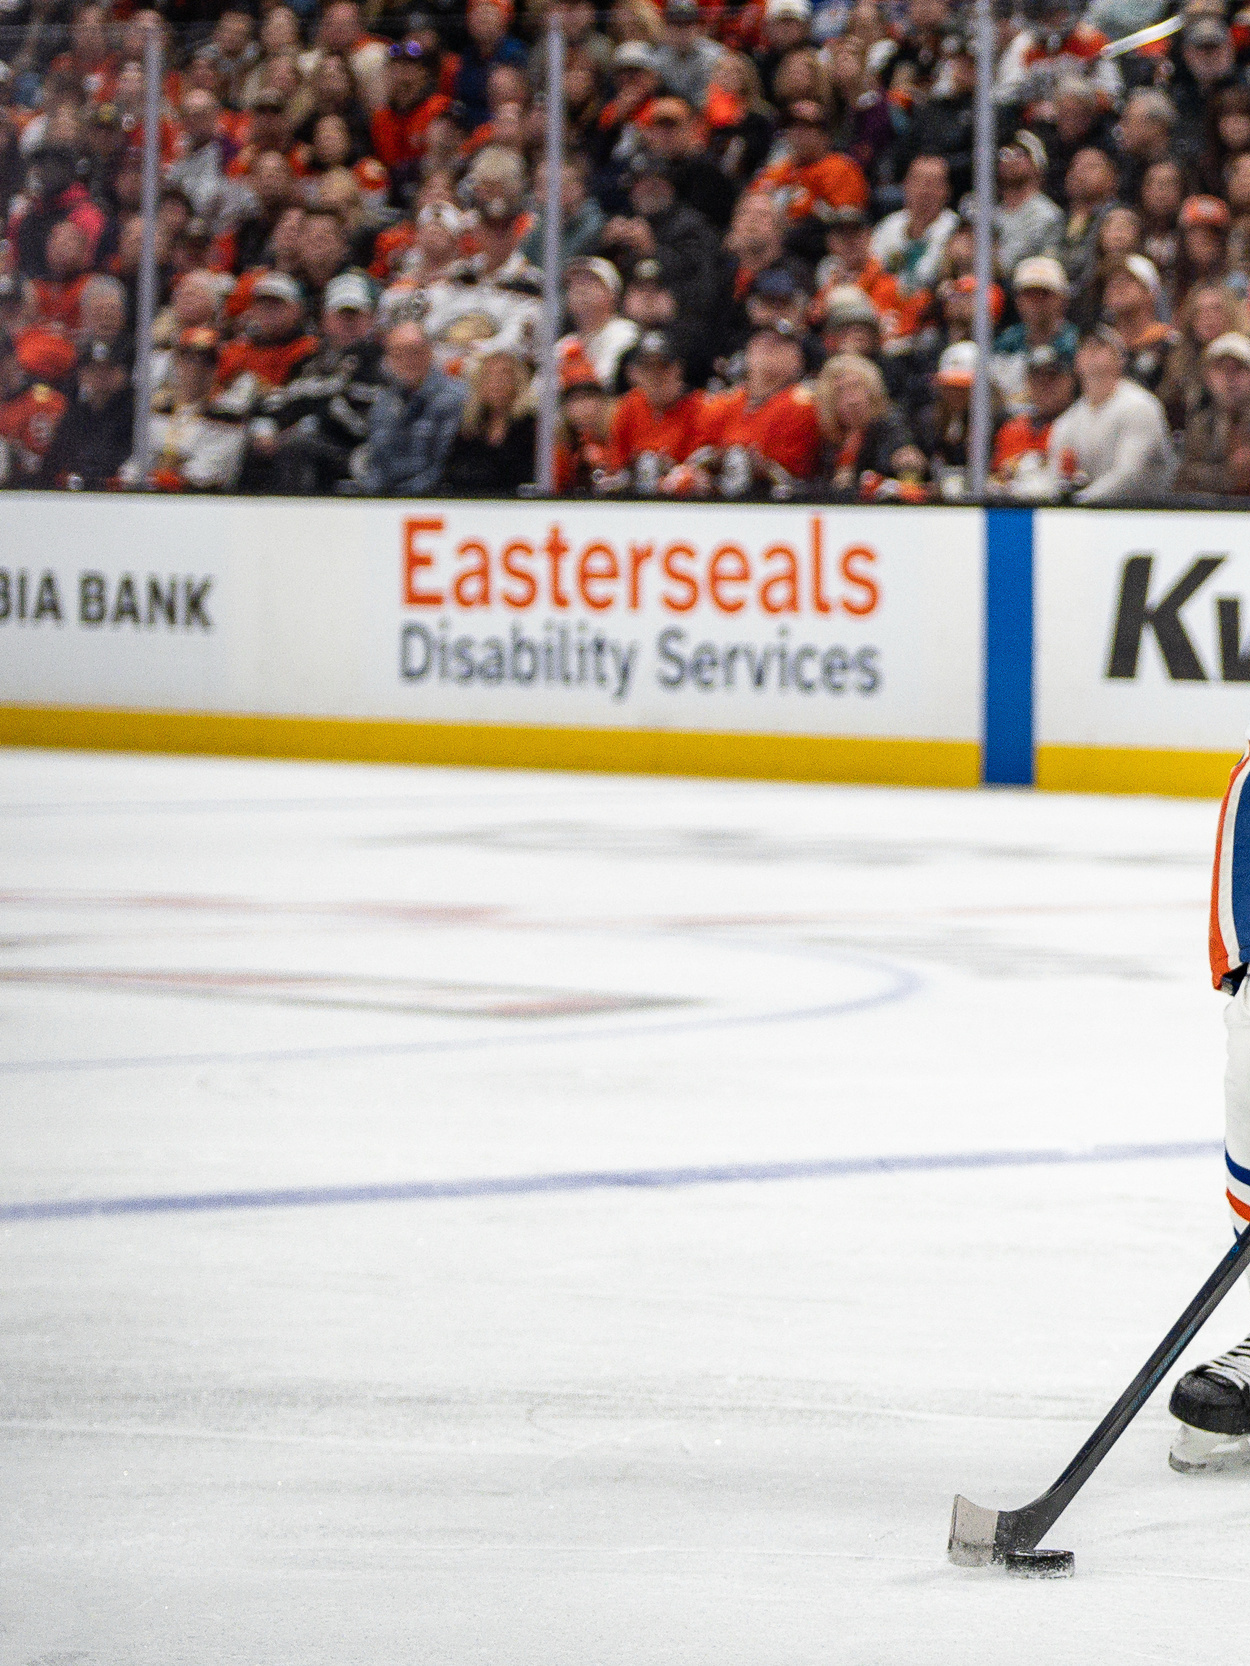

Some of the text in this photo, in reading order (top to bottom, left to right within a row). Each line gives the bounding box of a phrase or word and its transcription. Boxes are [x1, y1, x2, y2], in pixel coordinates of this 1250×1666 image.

[79, 572, 213, 627] BANK
[402, 512, 881, 616] Easterseals
[400, 620, 882, 704] Disability Services
